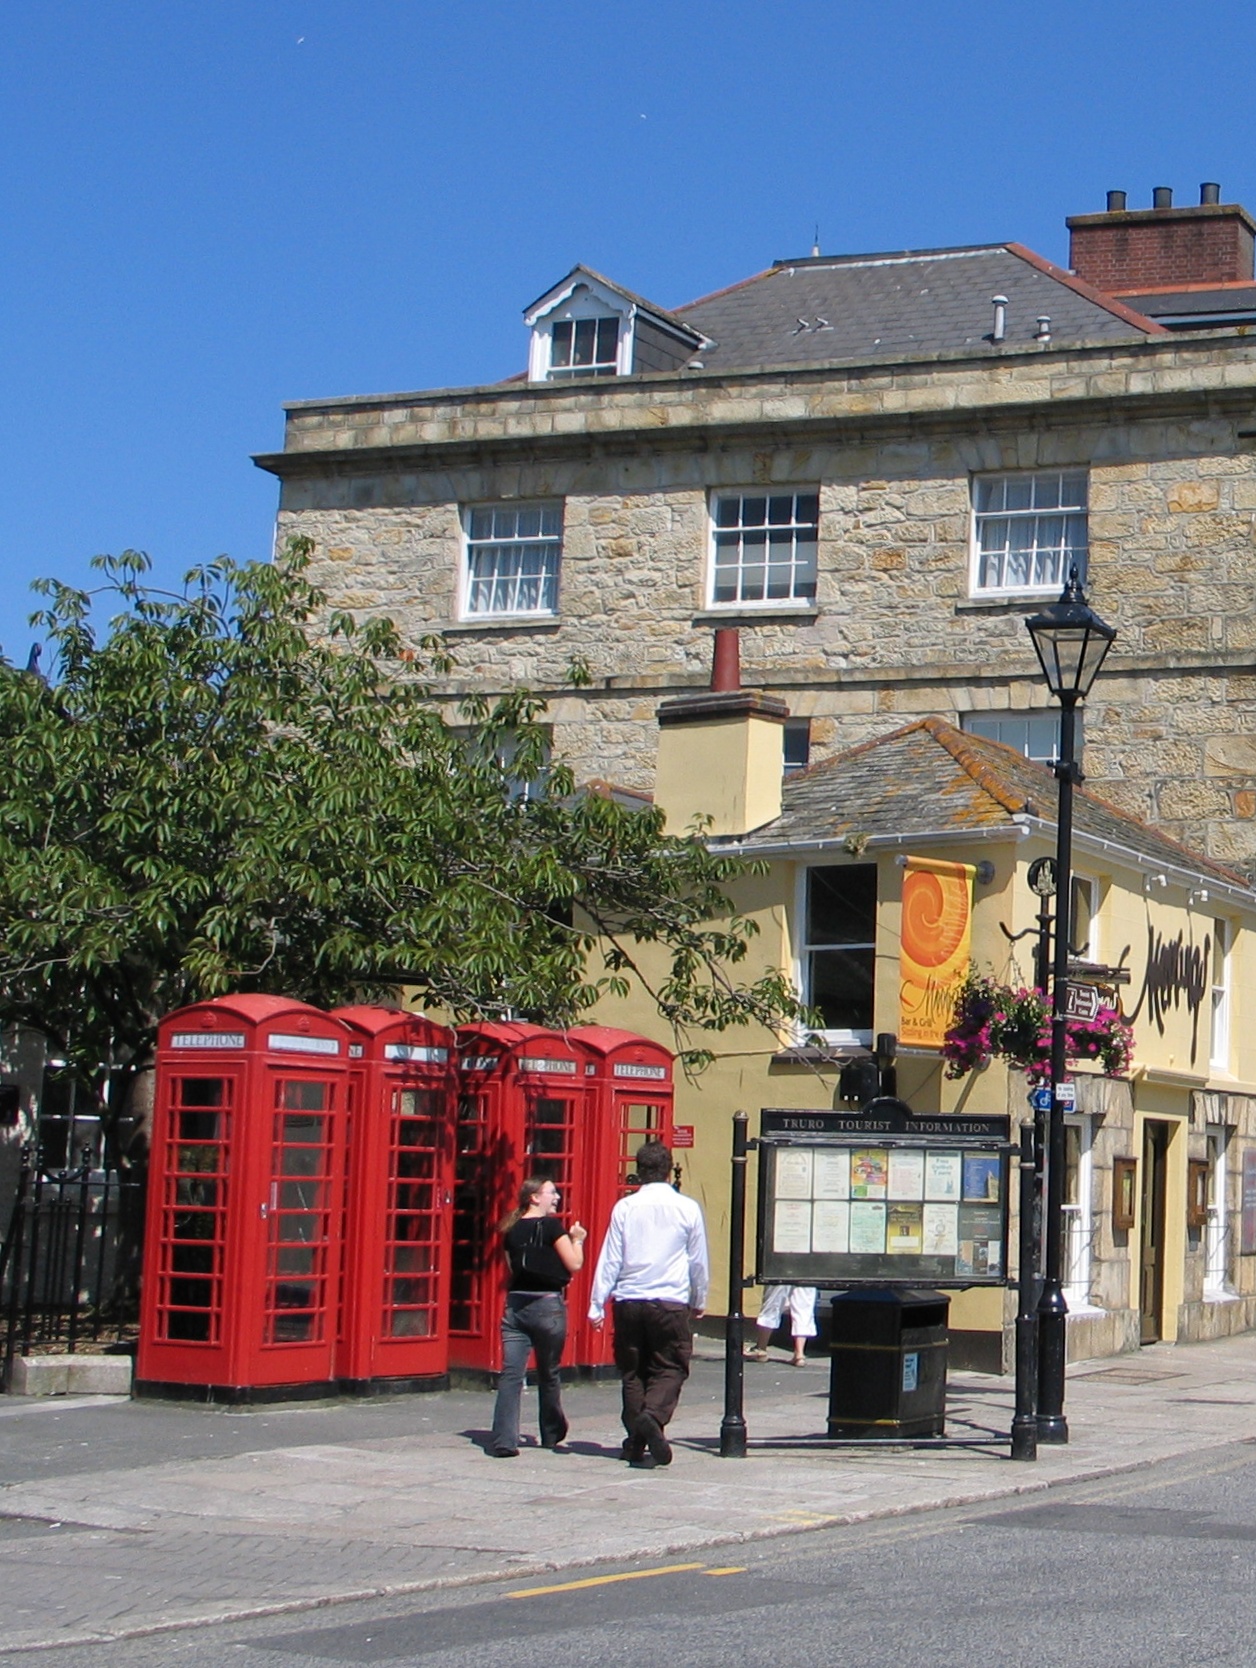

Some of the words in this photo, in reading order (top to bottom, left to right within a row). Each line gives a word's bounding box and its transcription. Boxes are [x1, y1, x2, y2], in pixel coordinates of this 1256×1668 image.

[174, 1034, 244, 1048] TELEPHONE
[616, 1064, 662, 1078] TELEPHONE
[783, 1118, 825, 1130] TRURO
[838, 1119, 891, 1131] TOURIST
[905, 1120, 990, 1133] INFORMATION
